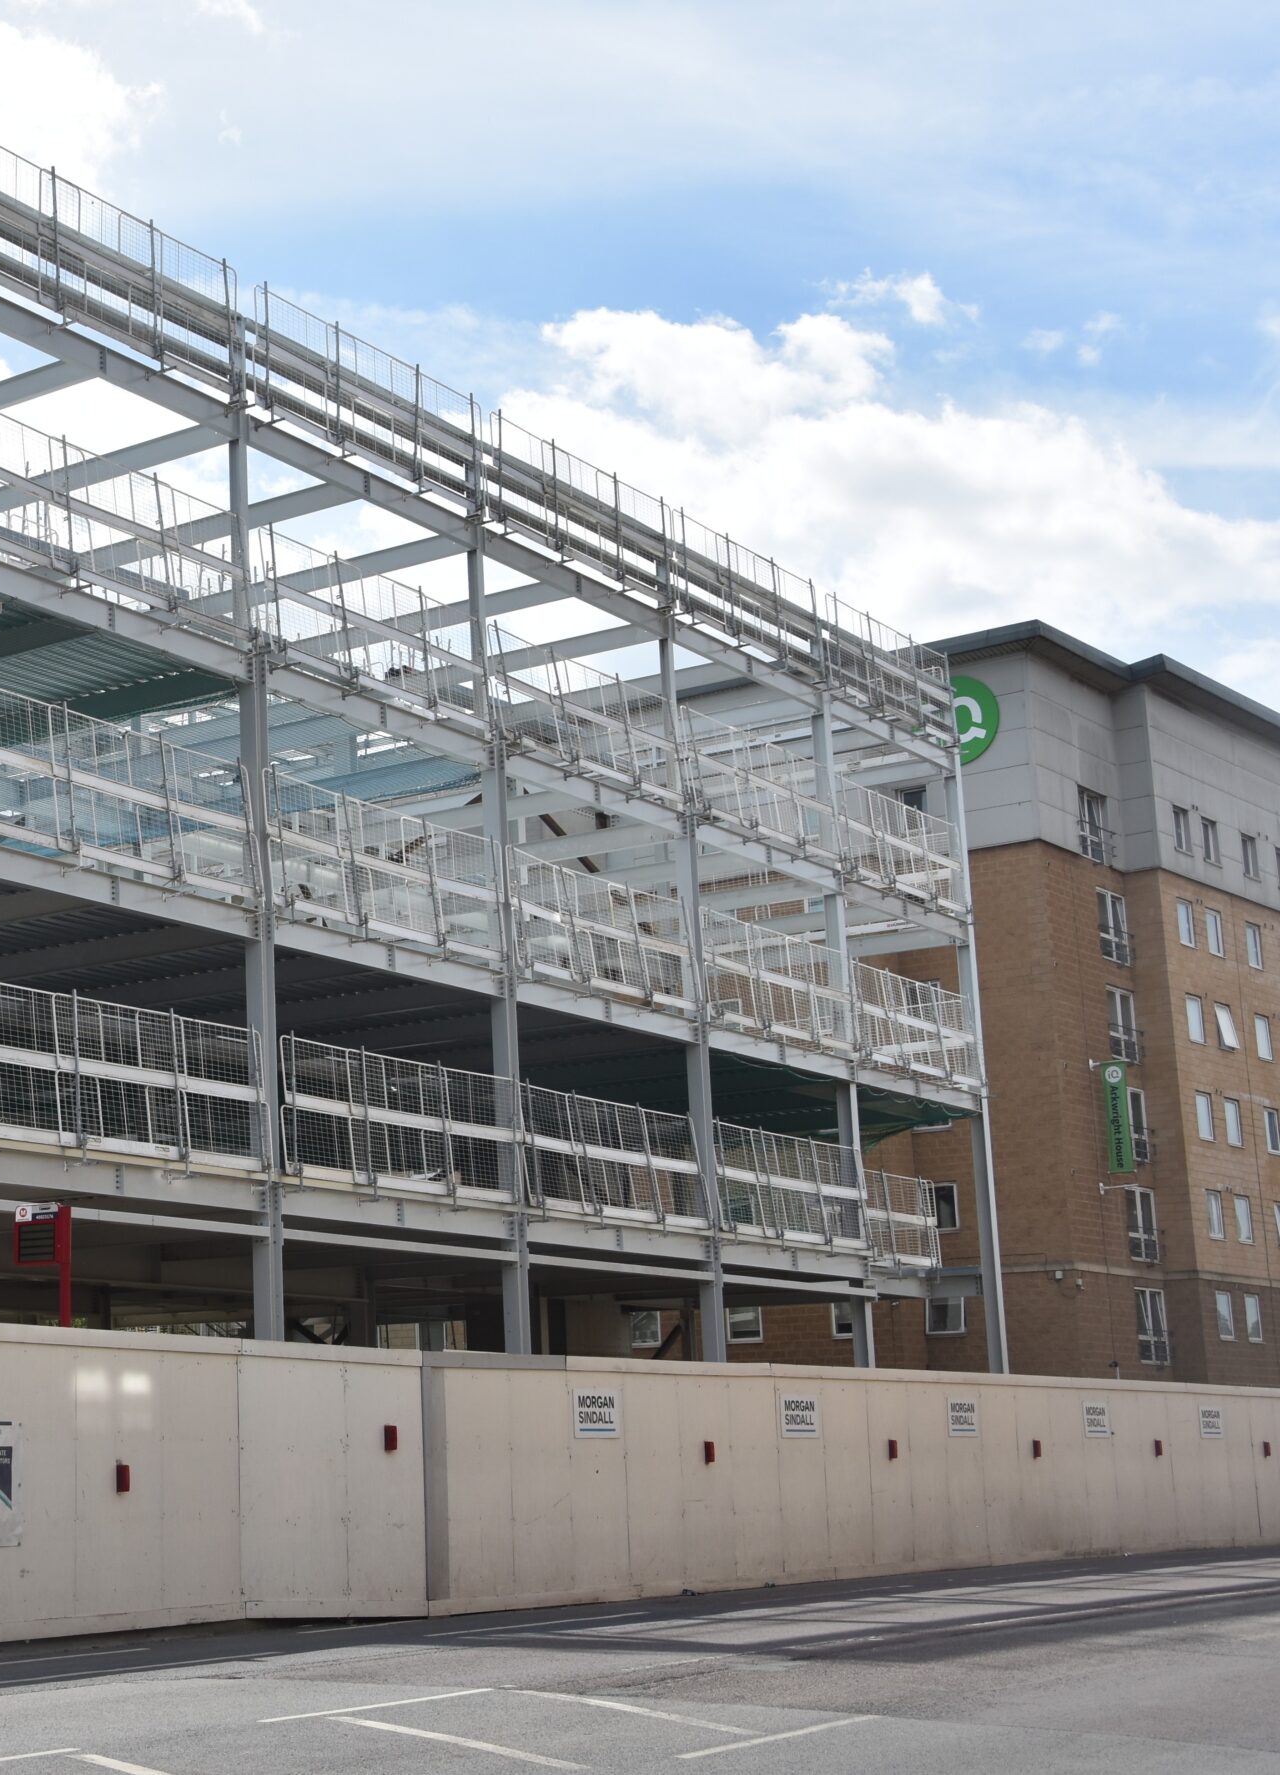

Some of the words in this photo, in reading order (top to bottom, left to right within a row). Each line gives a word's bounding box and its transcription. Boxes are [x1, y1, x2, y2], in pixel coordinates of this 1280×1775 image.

[1110, 1085, 1123, 1135] Arkwright
[1115, 1137, 1125, 1169] House
[578, 1395, 615, 1409] MORGAN
[784, 1400, 815, 1411] MORGAN
[951, 1402, 975, 1413] MORGAN
[578, 1411, 614, 1424] SINDALL
[785, 1414, 814, 1426] SINDALL
[951, 1415, 975, 1425] SINDALL
